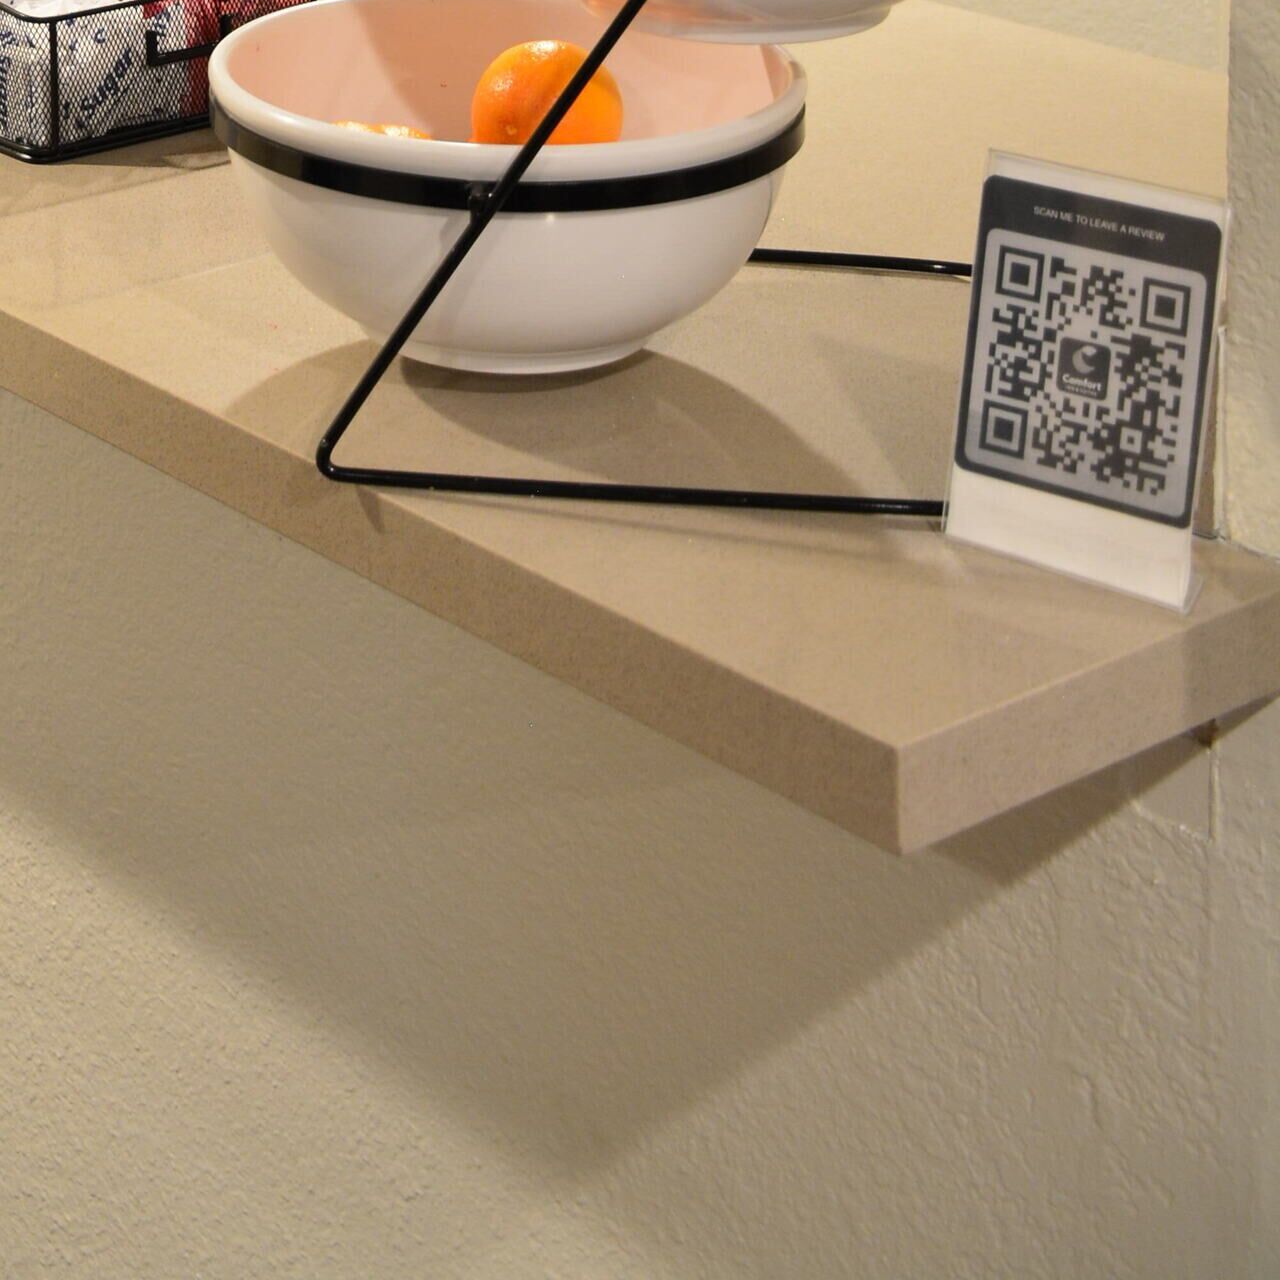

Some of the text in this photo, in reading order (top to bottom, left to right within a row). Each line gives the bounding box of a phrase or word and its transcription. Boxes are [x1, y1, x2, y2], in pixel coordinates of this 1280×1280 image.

[1033, 205, 1166, 242] SCAN ME TO LEAVE A REVIEW
[1062, 373, 1102, 392] Comfort
